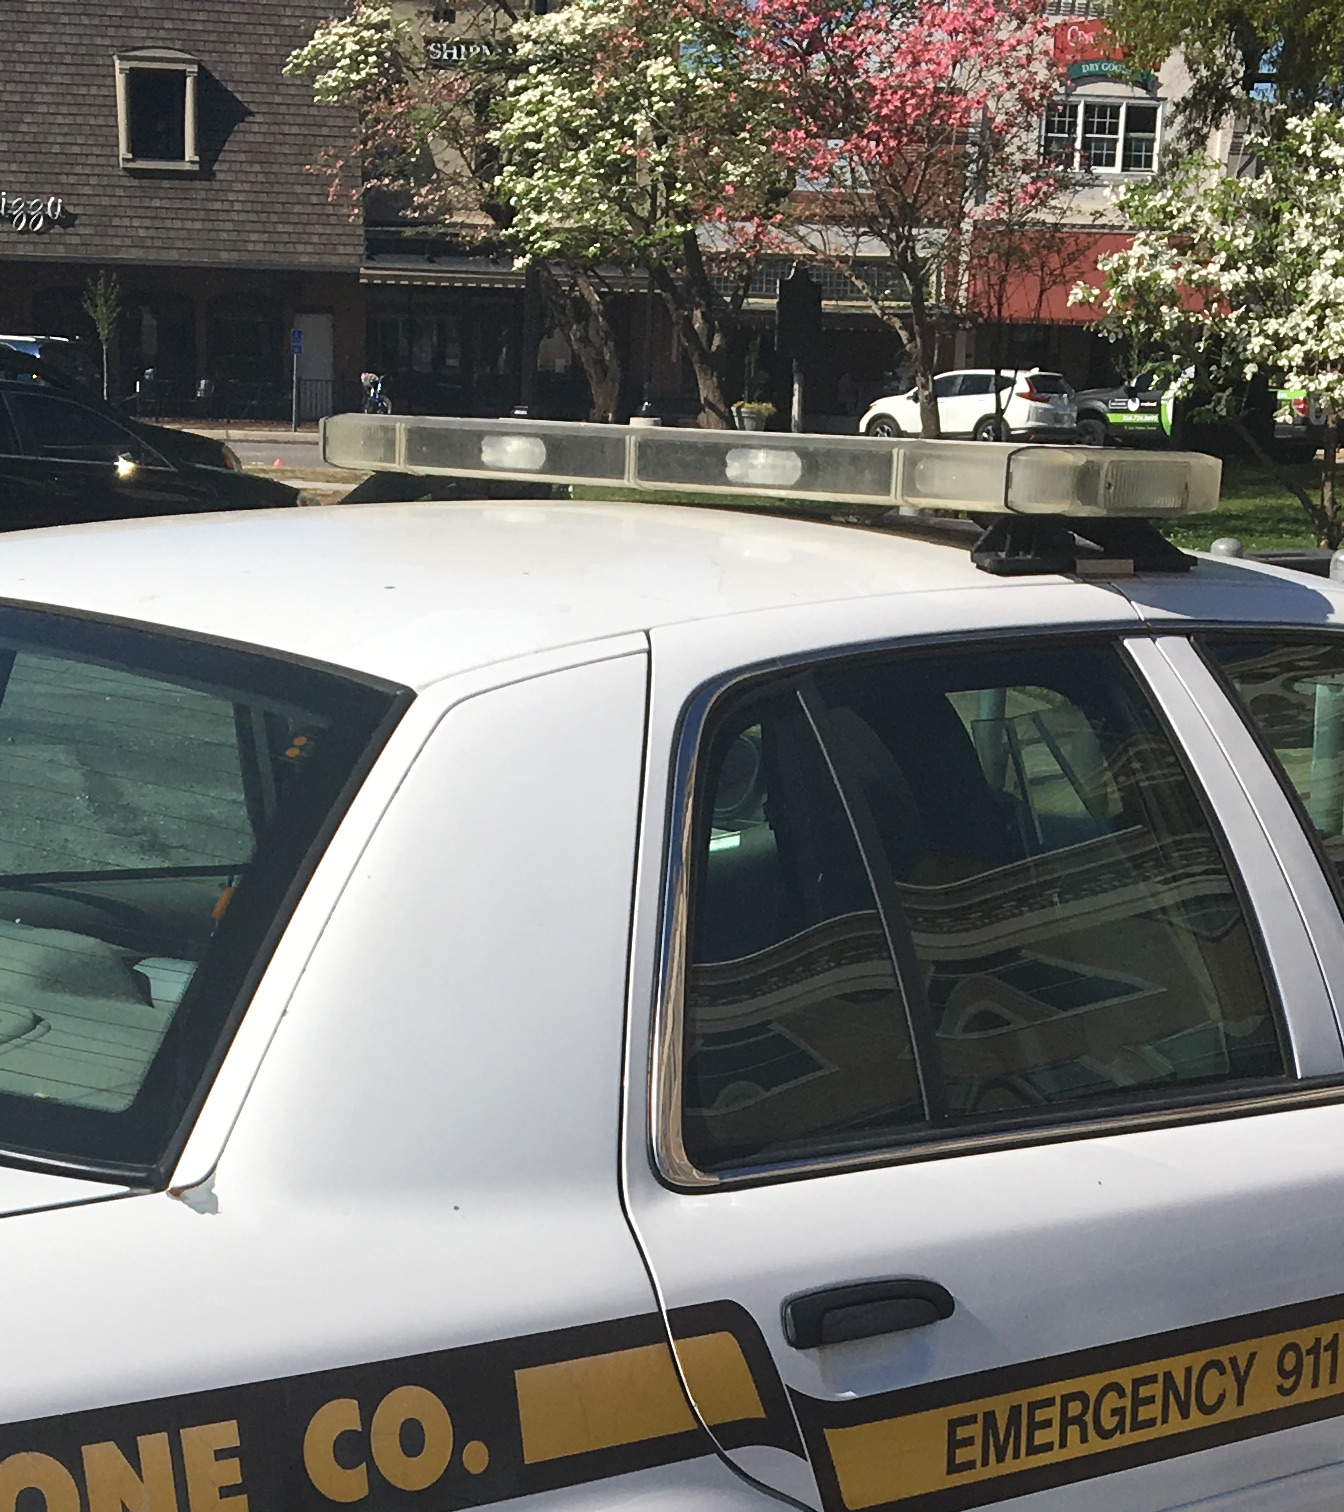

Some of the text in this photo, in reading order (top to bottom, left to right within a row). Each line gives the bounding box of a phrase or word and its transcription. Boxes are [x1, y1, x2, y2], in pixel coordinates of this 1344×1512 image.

[1081, 62, 1099, 73] DRY
[302, 1384, 489, 1504] CO.
[945, 1333, 1340, 1477] EMERGENCY 911
